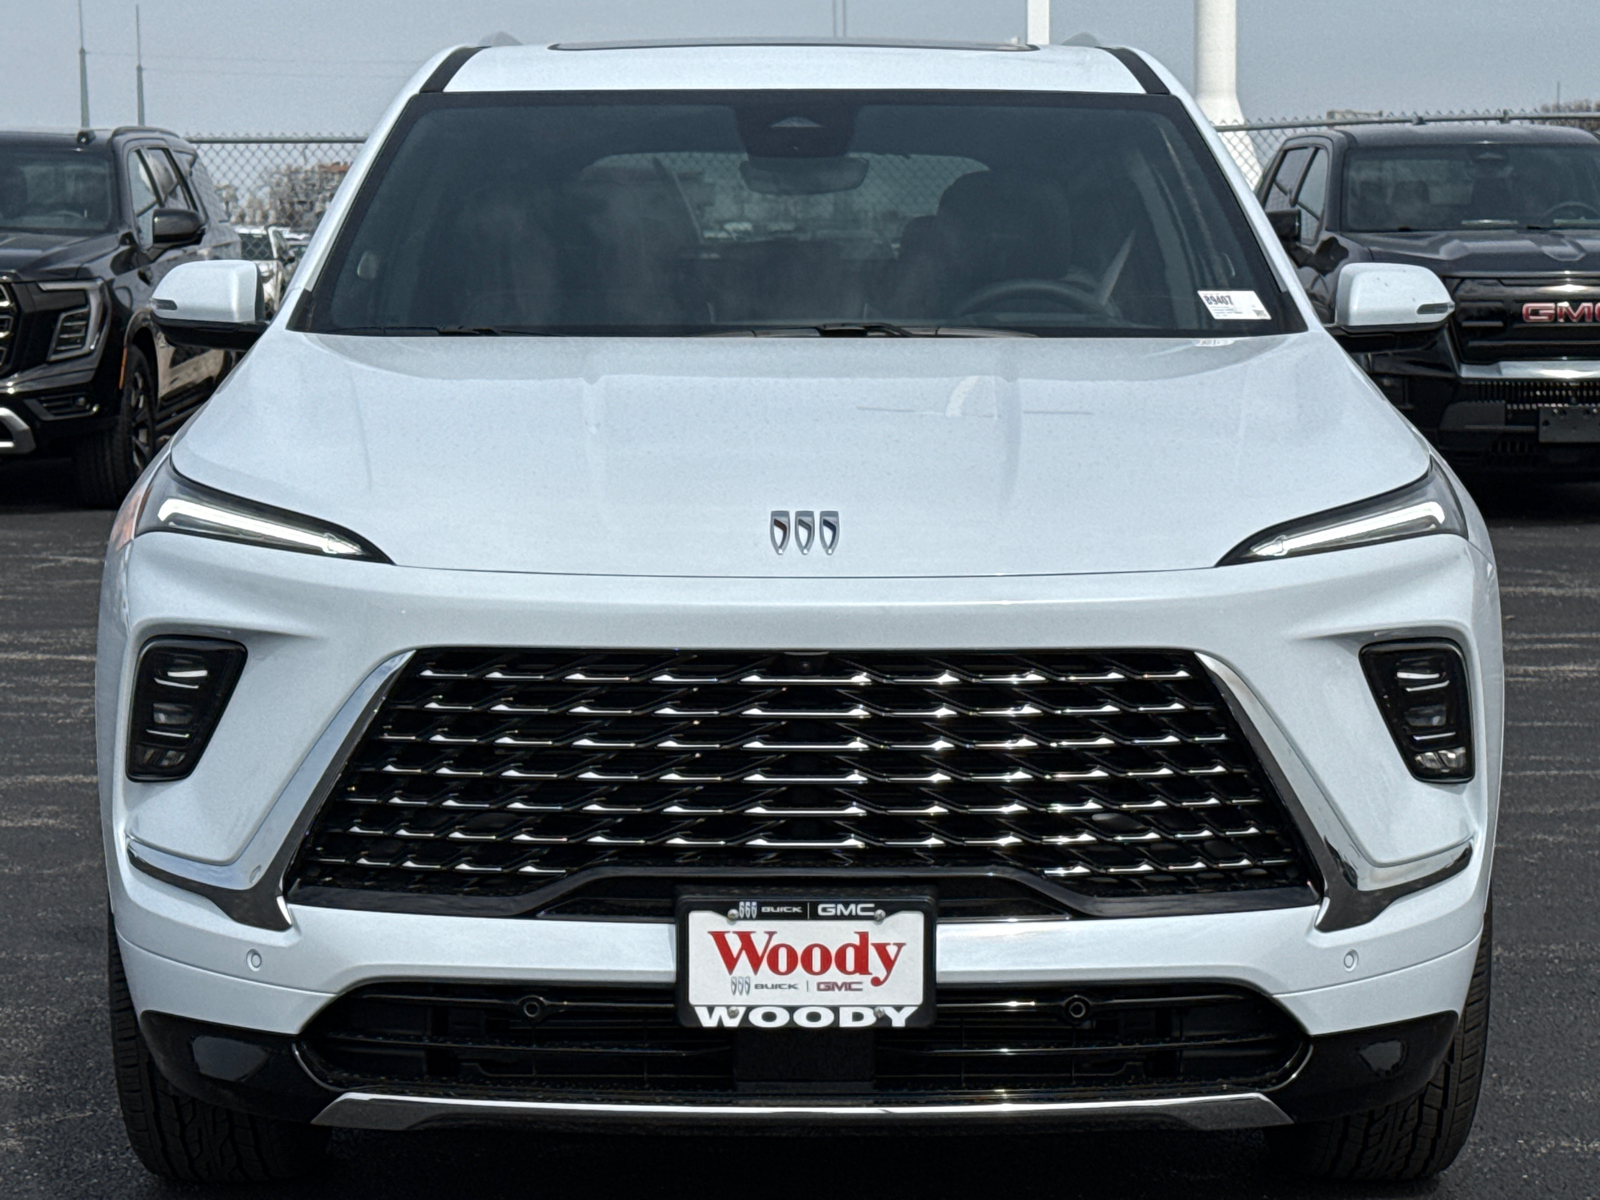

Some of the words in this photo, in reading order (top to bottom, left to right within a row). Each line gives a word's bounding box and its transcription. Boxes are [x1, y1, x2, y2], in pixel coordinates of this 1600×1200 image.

[1522, 302, 1600, 322] GM
[817, 903, 876, 917] GMC
[707, 930, 907, 987] Woody
[816, 981, 863, 992] GMC
[694, 1006, 919, 1028] WOODY
